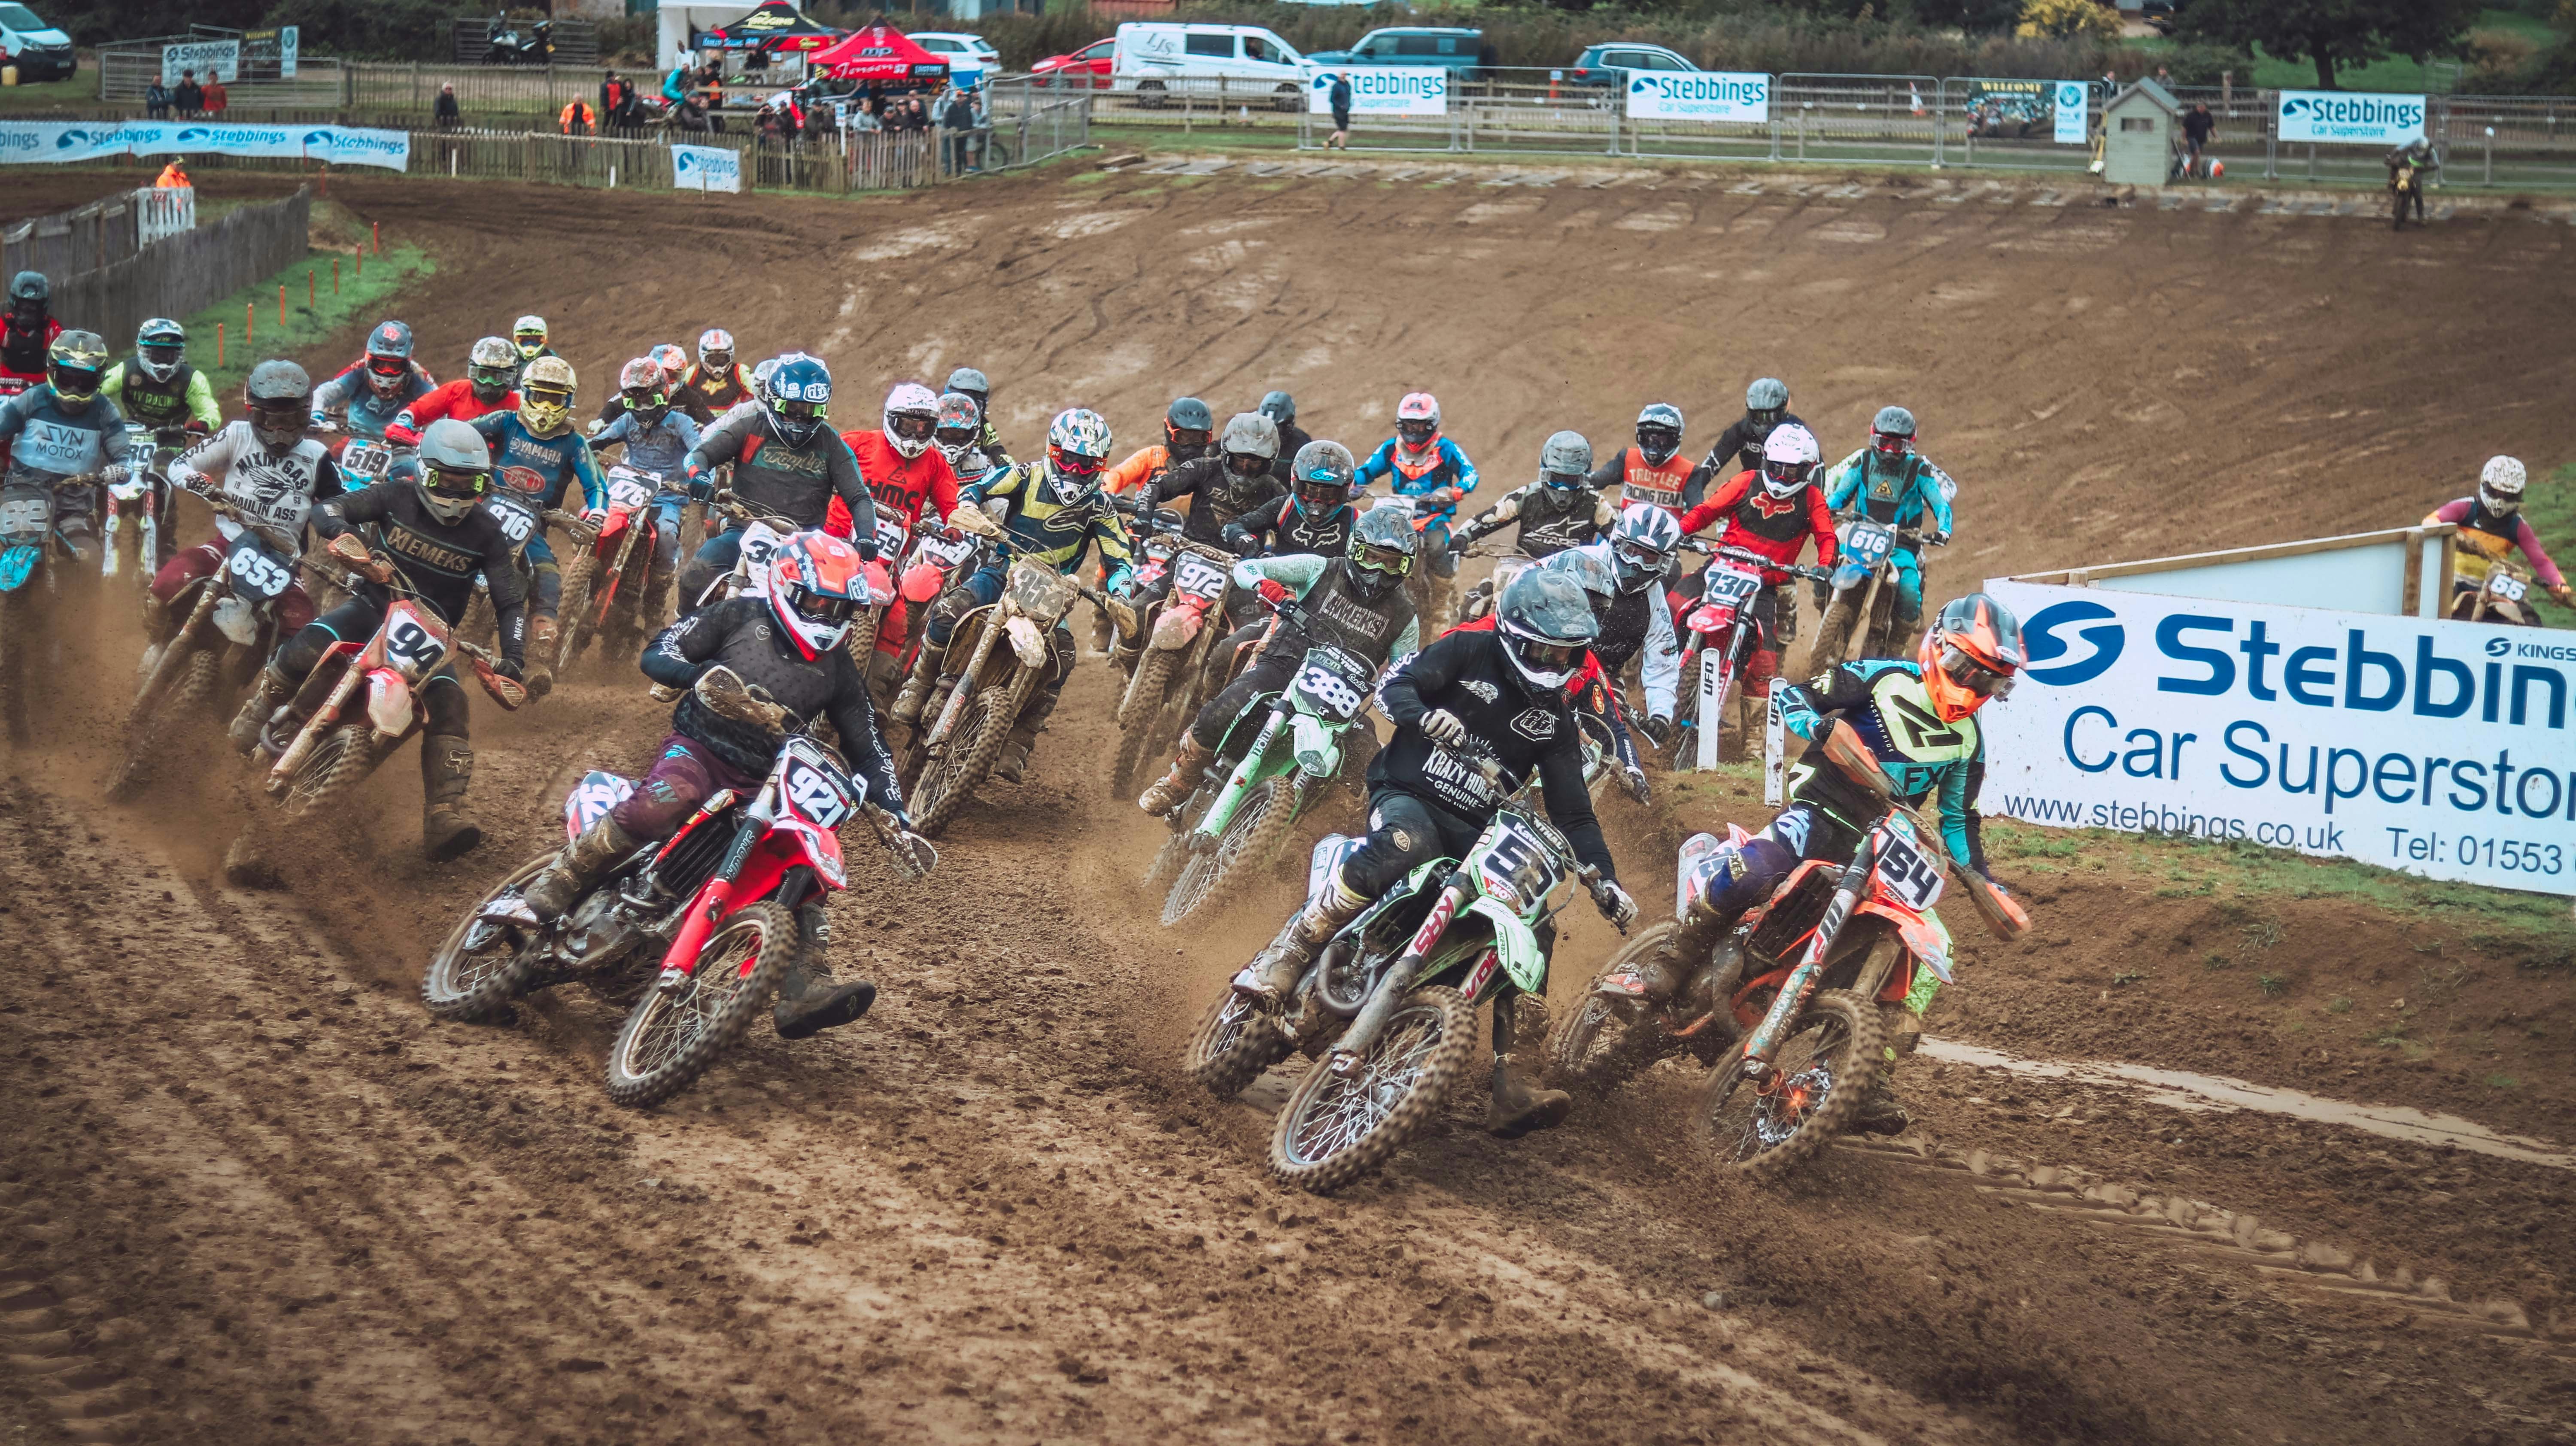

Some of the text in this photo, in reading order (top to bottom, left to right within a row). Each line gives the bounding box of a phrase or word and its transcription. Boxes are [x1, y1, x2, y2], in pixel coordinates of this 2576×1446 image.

[1346, 72, 1444, 99] tebbings
[1660, 76, 1765, 106] Stebbings
[2312, 98, 2422, 129] Stebbings
[90, 128, 162, 146] Stebbings
[211, 129, 287, 144] Stebbings
[36, 443, 83, 461] MOTOX
[344, 447, 390, 475] 519
[520, 440, 562, 465] YAMAHA
[282, 459, 309, 490] GAS
[1629, 468, 1682, 490] TROY LEE
[230, 493, 297, 521] HAULIN ASS
[293, 496, 301, 505] 68
[1850, 530, 1889, 554] 616
[230, 547, 291, 596] 653
[1176, 562, 1228, 599] 972
[2491, 573, 2527, 601] 55
[386, 622, 444, 673] 94
[2518, 643, 2576, 662] KINGS
[1704, 662, 1714, 696] UFO
[2156, 613, 2576, 729] Stebbin
[1298, 666, 1361, 719] 388
[1770, 690, 1780, 727] UFO
[1869, 699, 1894, 753] FACTORY RIDE
[2064, 705, 2196, 781] Car
[1422, 746, 1466, 784] KRAZY
[787, 768, 847, 828] 921
[1434, 778, 1479, 808] GENUINE
[1439, 793, 1452, 802] WILD
[1513, 821, 1559, 870] Kawasaki
[1533, 817, 1564, 850] NTHAL
[2005, 794, 2562, 875] www.stebbings.co.uk Tel: 01553
